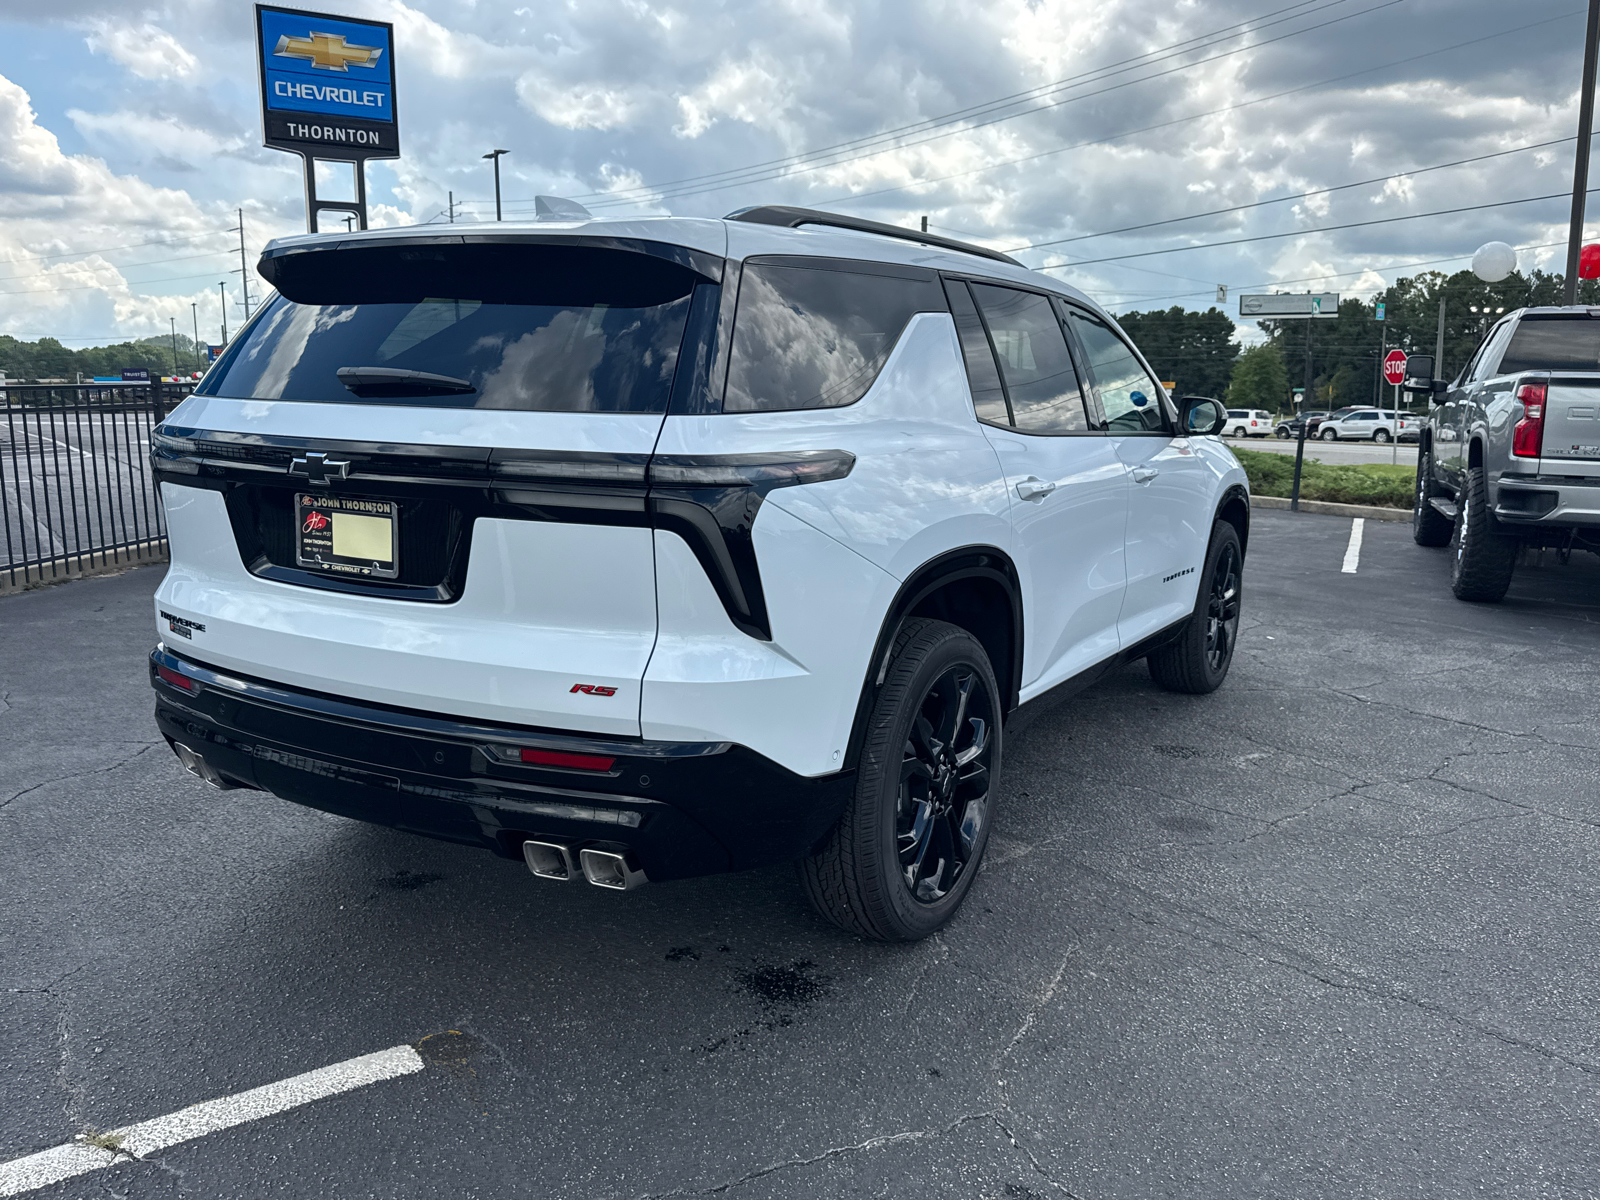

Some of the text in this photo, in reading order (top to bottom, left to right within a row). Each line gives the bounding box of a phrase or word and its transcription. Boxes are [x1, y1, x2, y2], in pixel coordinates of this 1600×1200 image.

[274, 81, 385, 107] CHEVROLET
[287, 122, 380, 145] THORNTON
[1385, 360, 1407, 374] STOP
[317, 497, 340, 508] JOHN
[342, 500, 391, 513] THORNTON
[331, 565, 360, 573] CHEVROLET
[1162, 566, 1195, 583] TRAVERSE
[159, 609, 206, 633] TRAVERSE
[569, 683, 619, 697] RS
